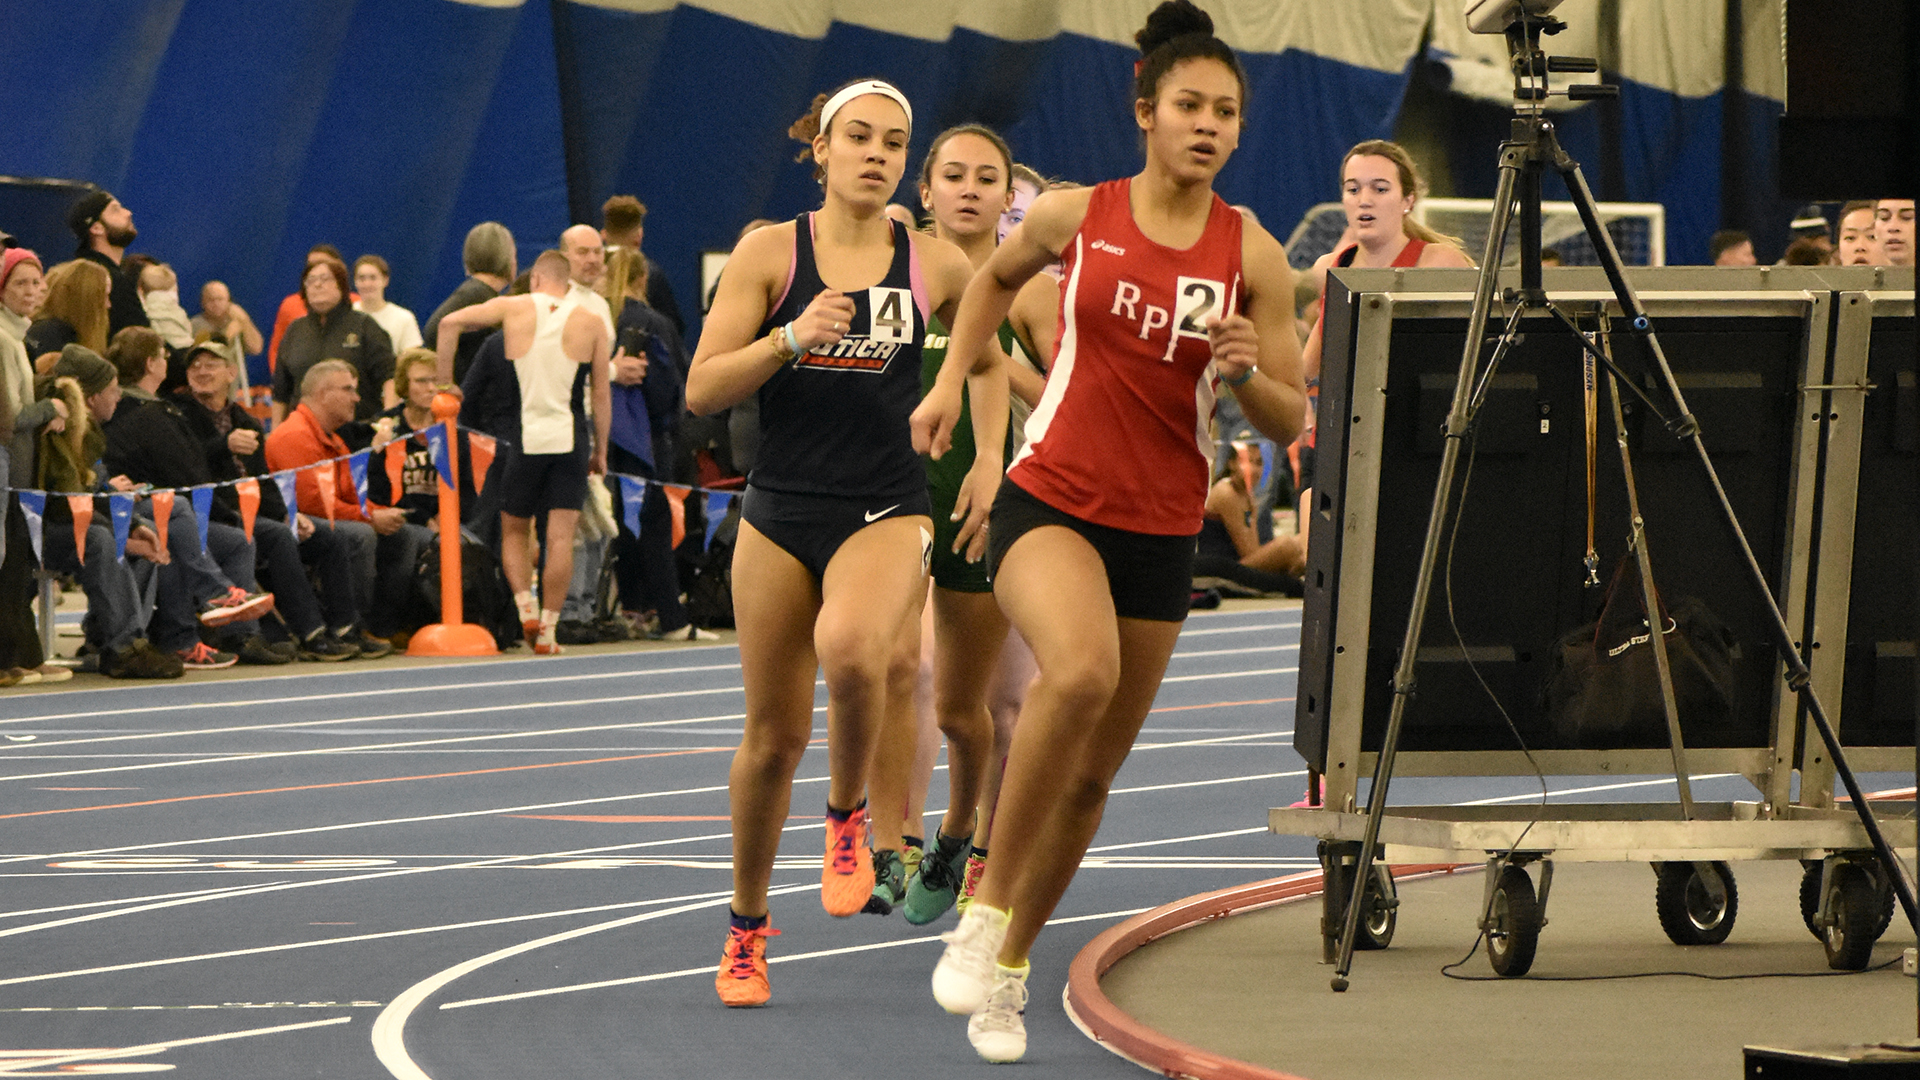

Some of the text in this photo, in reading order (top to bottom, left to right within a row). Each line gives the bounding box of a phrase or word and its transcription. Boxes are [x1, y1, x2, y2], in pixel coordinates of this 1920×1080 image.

[1101, 242, 1126, 256] asics
[875, 291, 907, 338] 4
[1178, 283, 1216, 335] 2
